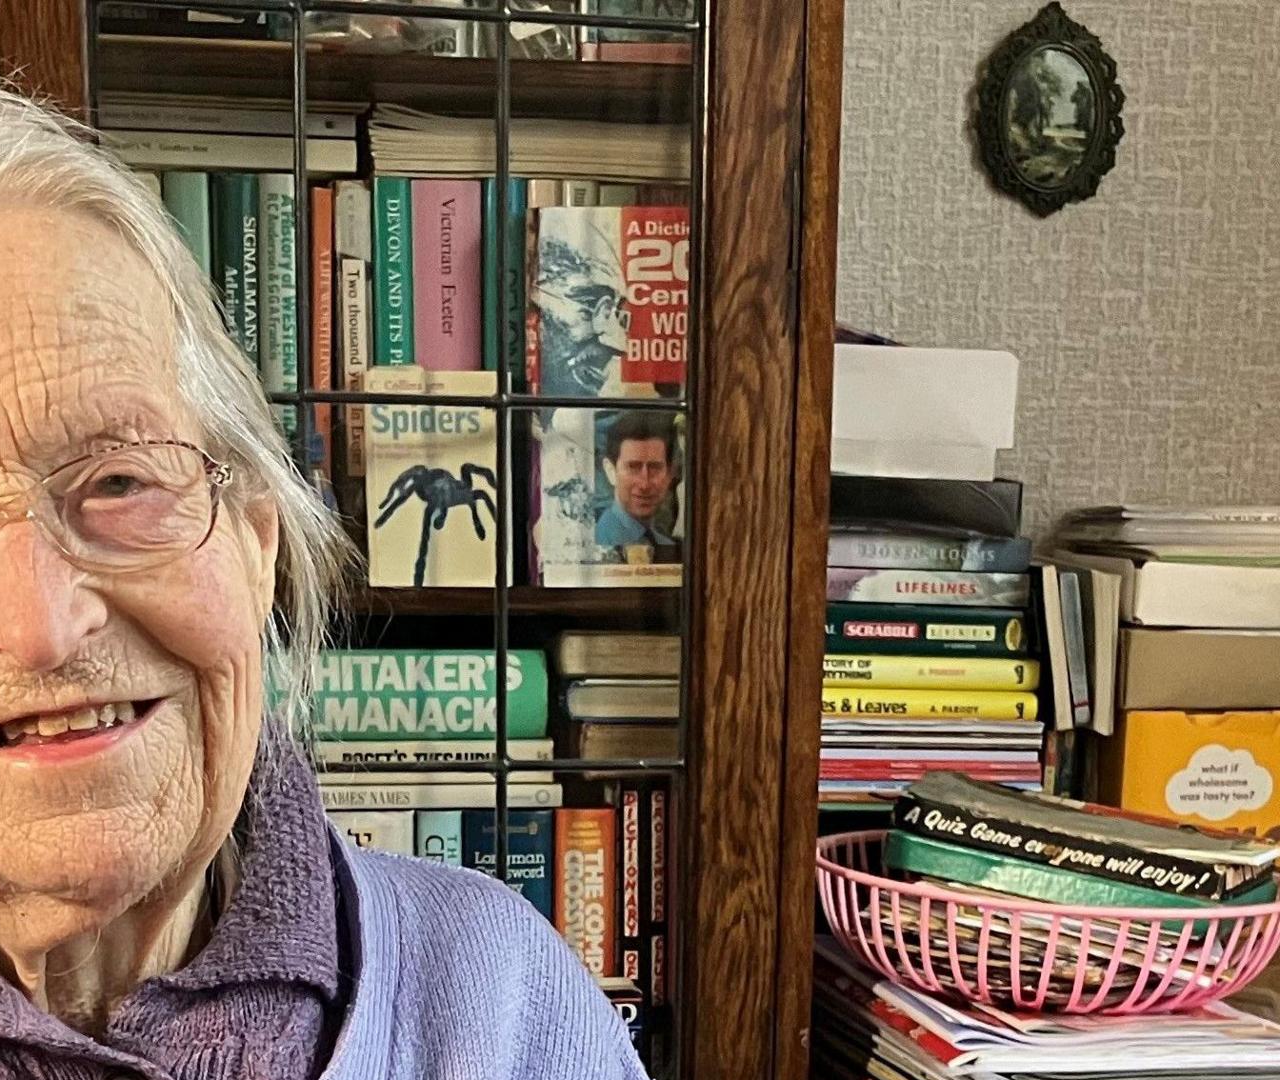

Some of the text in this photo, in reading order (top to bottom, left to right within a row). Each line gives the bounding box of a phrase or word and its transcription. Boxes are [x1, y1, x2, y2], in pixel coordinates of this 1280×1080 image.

[627, 221, 689, 236] A Dicti
[386, 200, 403, 342] DEVON AND ITS
[440, 198, 457, 337] Victorian Exeter
[347, 270, 360, 298] Two
[348, 304, 363, 365] thousand
[371, 403, 480, 440] Spiders
[895, 580, 977, 594] LIFELINES
[846, 623, 917, 639] SCRABBLE
[320, 652, 523, 692] HITAKER'S
[841, 700, 852, 714] &
[857, 700, 908, 714] Leaves
[1201, 763, 1240, 775] what if
[1188, 777, 1249, 788] wholesome
[370, 790, 411, 805] NAMES
[1179, 789, 1256, 804] was tasty too?
[903, 806, 921, 825] A
[924, 809, 967, 836] Quiz
[969, 822, 1021, 849] Game
[1025, 838, 1106, 870] everyone
[1106, 851, 1141, 877] will
[585, 850, 605, 896] THE
